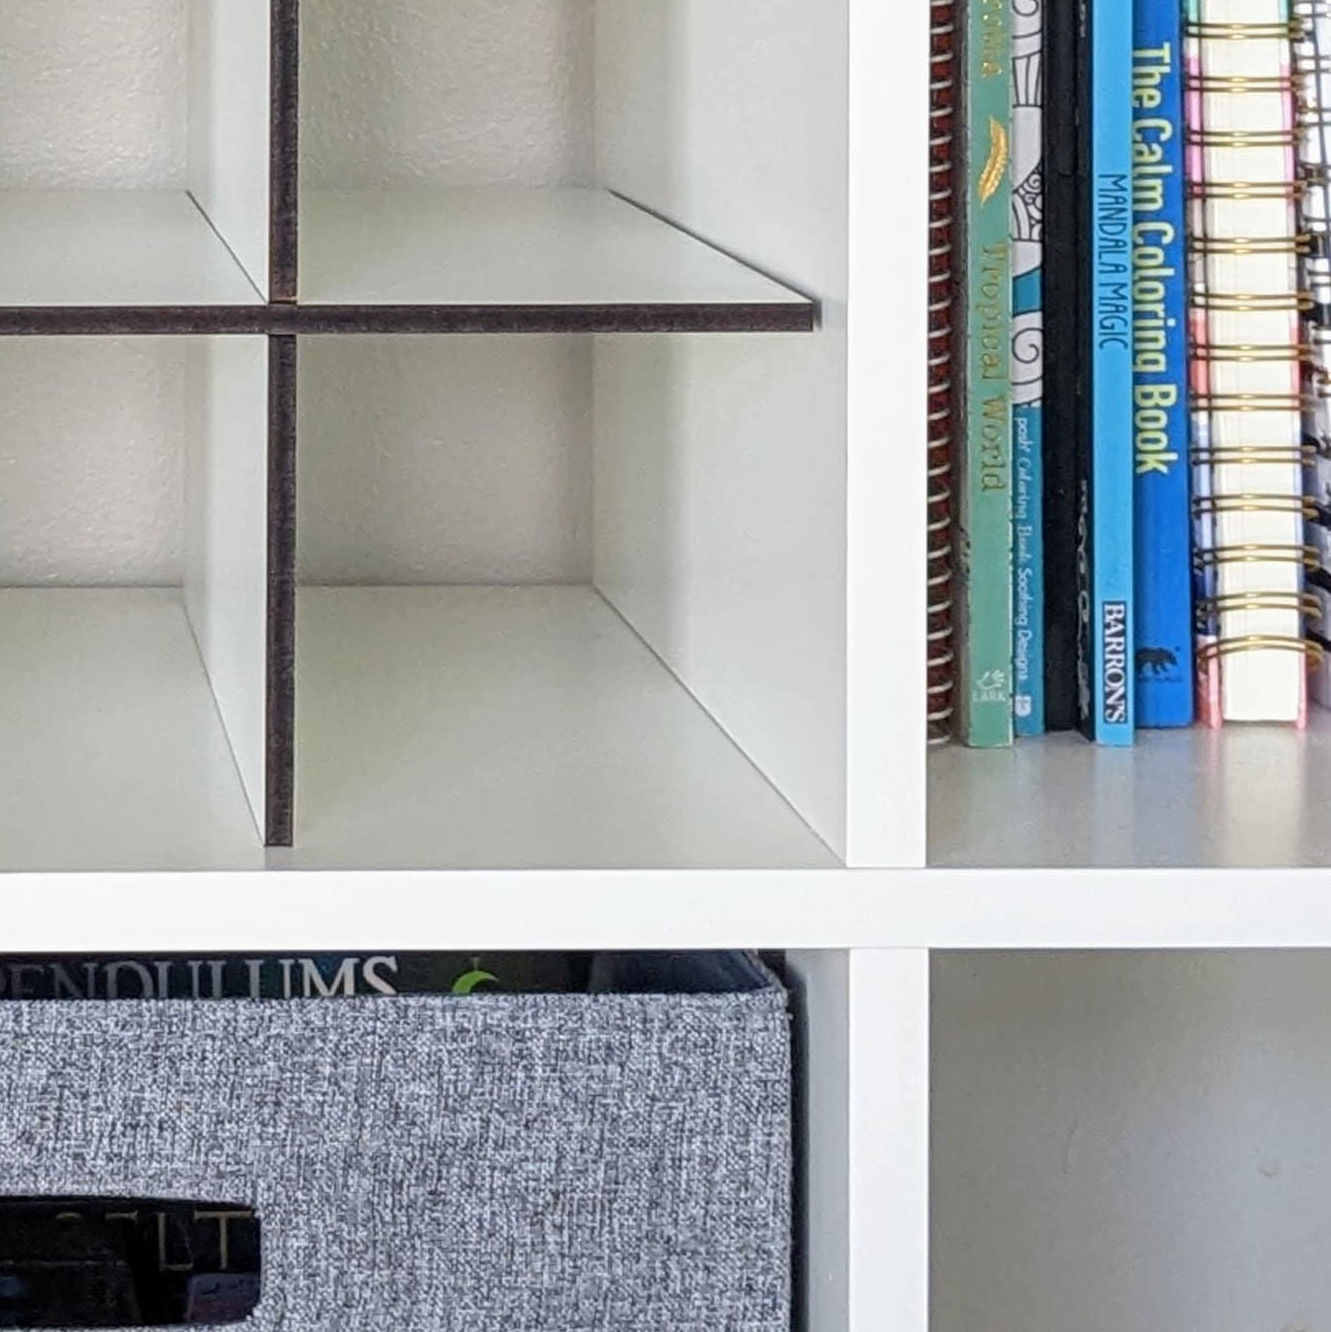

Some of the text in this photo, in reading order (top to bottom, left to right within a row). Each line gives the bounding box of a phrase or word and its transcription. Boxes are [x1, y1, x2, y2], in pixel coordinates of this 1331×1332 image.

[1098, 174, 1129, 350] MANDALA MAGIC
[1132, 41, 1178, 475] The Calm Coloring Book
[976, 240, 1008, 493] Tropical World
[1015, 567, 1033, 626] Soothing
[1016, 629, 1034, 680] Designs
[1103, 602, 1128, 725] BARRON'S
